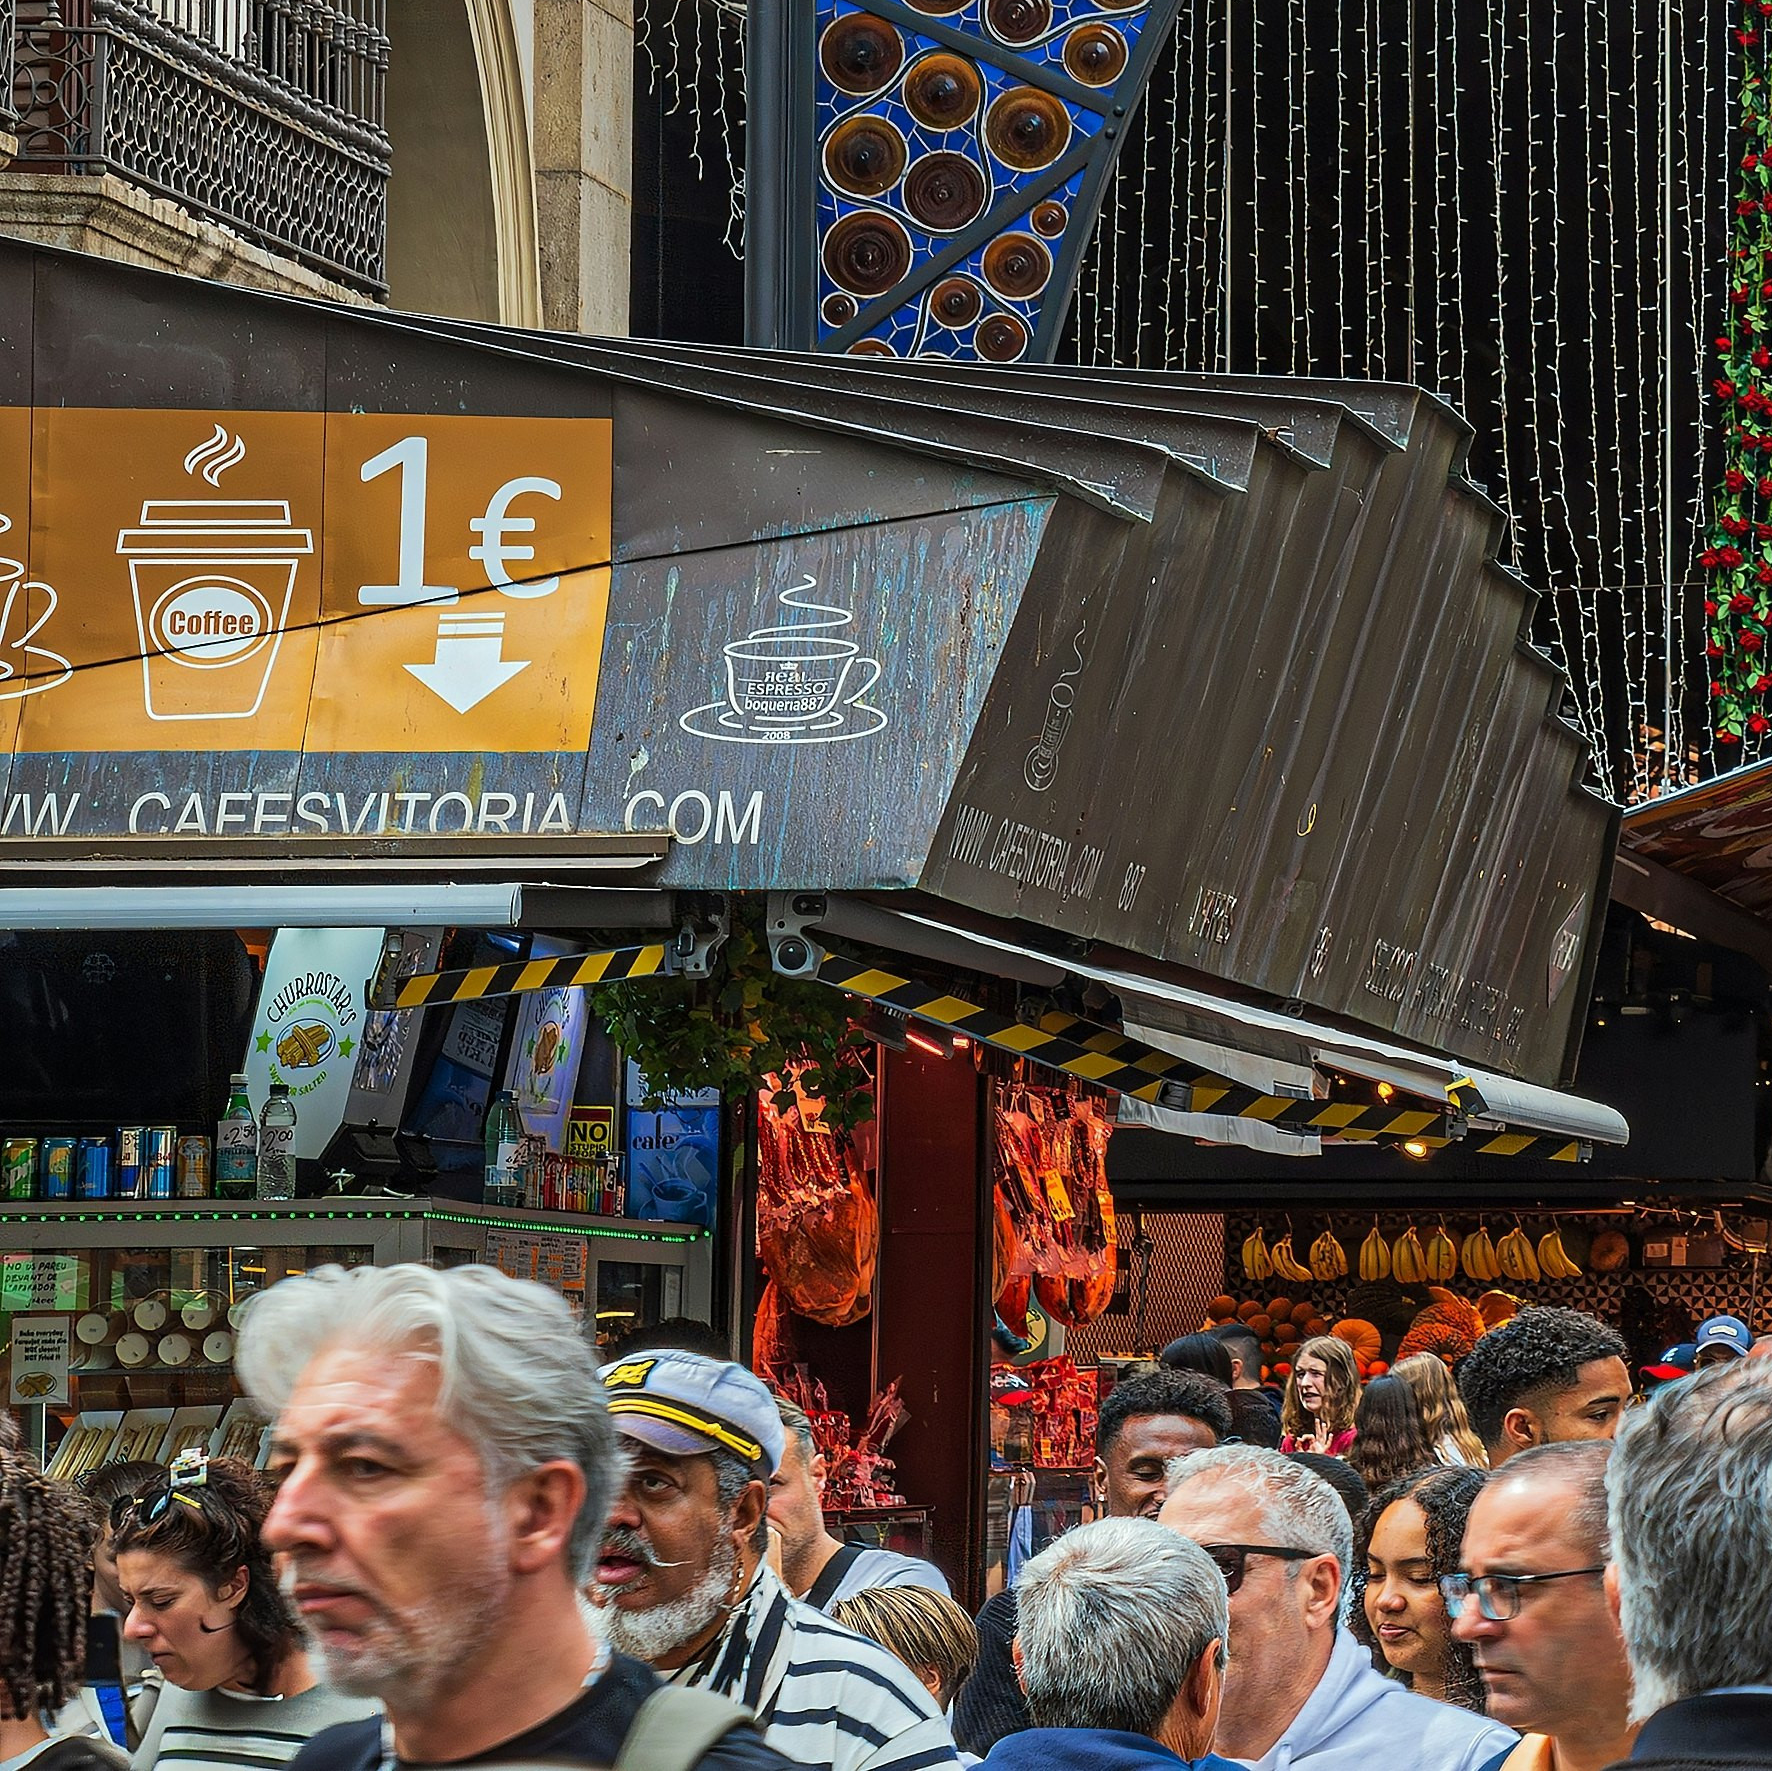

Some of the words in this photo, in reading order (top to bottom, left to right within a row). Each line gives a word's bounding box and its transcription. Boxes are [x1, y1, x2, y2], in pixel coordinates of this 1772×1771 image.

[169, 608, 254, 637] Coffee
[747, 682, 826, 695] ESPRESSO
[762, 731, 791, 740] 2008
[0, 791, 81, 836] W
[624, 790, 764, 846] COM
[1117, 861, 1147, 912] 887
[266, 971, 357, 1027] CHURROSTAR'S
[299, 1070, 328, 1096] SALTED
[570, 1122, 607, 1143] NO
[570, 1143, 606, 1151] STUPID
[6, 1262, 22, 1271] NO
[38, 1262, 67, 1271] PAREU
[5, 1273, 43, 1282] DEVANT
[47, 1273, 58, 1281] DE
